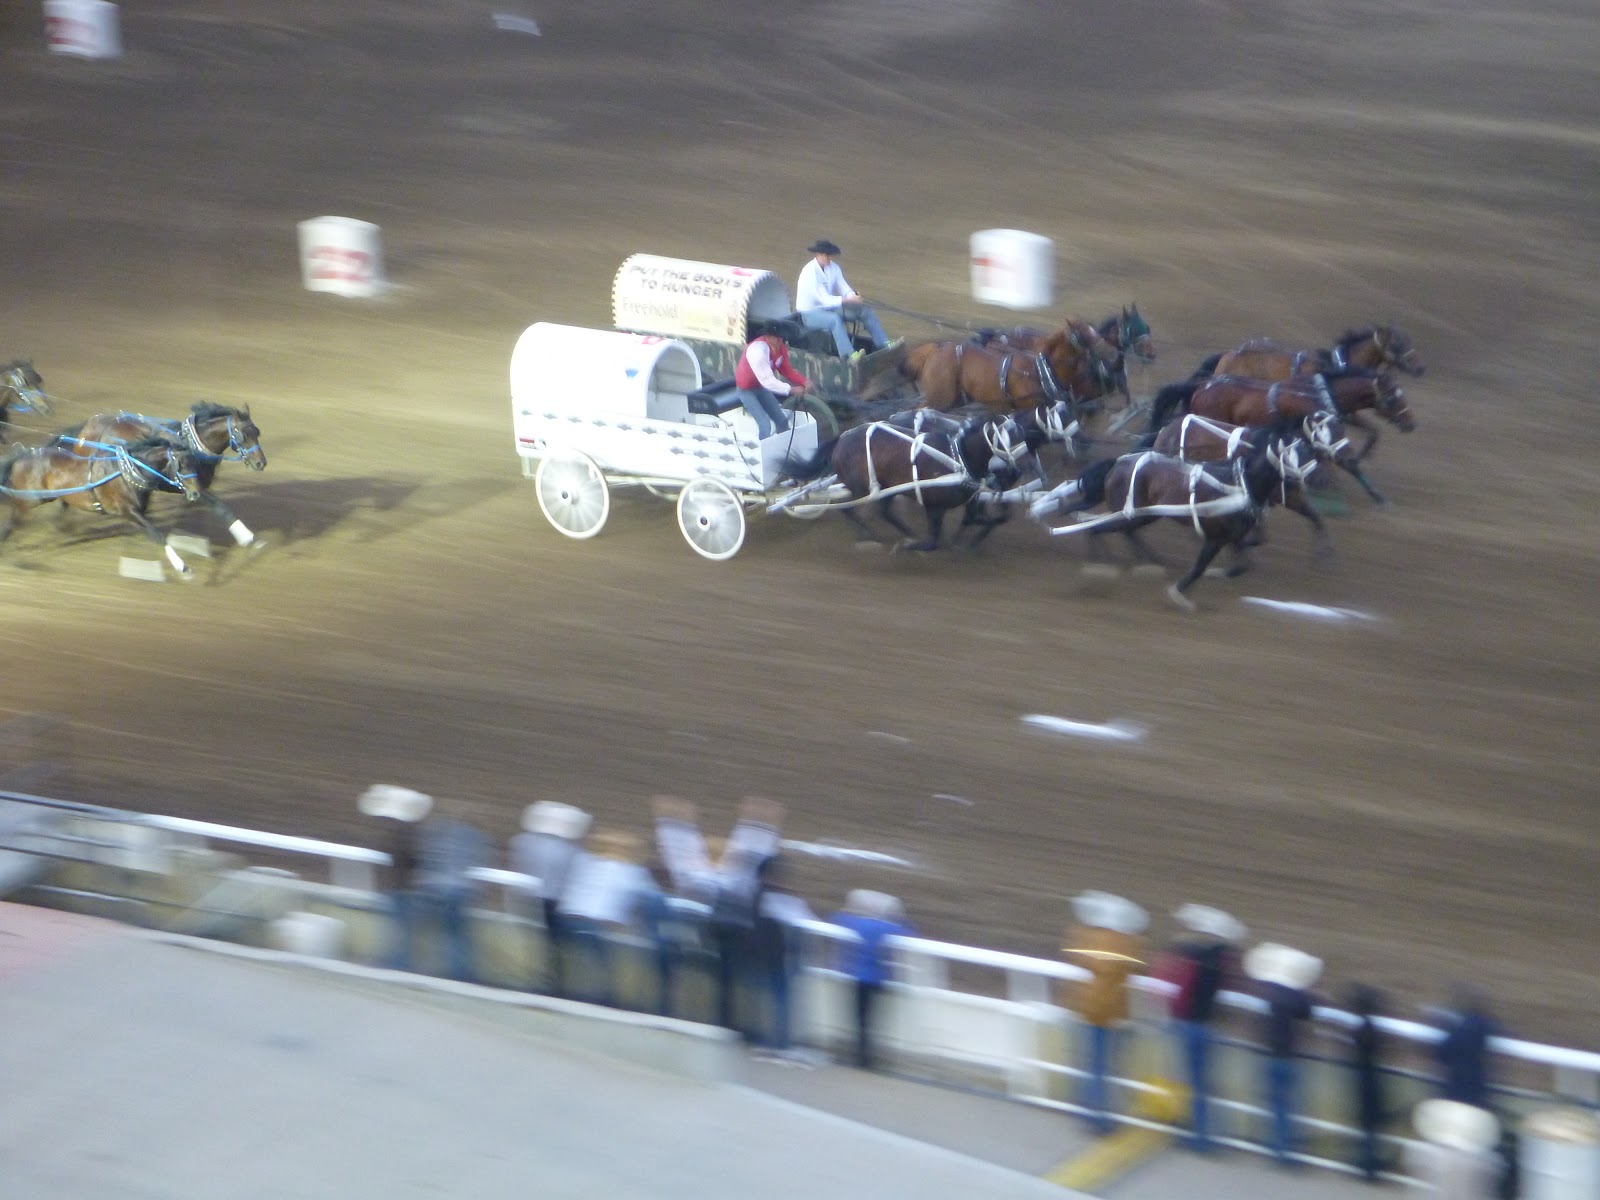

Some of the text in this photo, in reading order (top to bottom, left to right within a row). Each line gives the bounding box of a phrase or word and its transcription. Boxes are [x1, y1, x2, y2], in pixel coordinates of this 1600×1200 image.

[630, 265, 743, 289] PUT THE BOOTS
[640, 278, 723, 299] TO HUNGER
